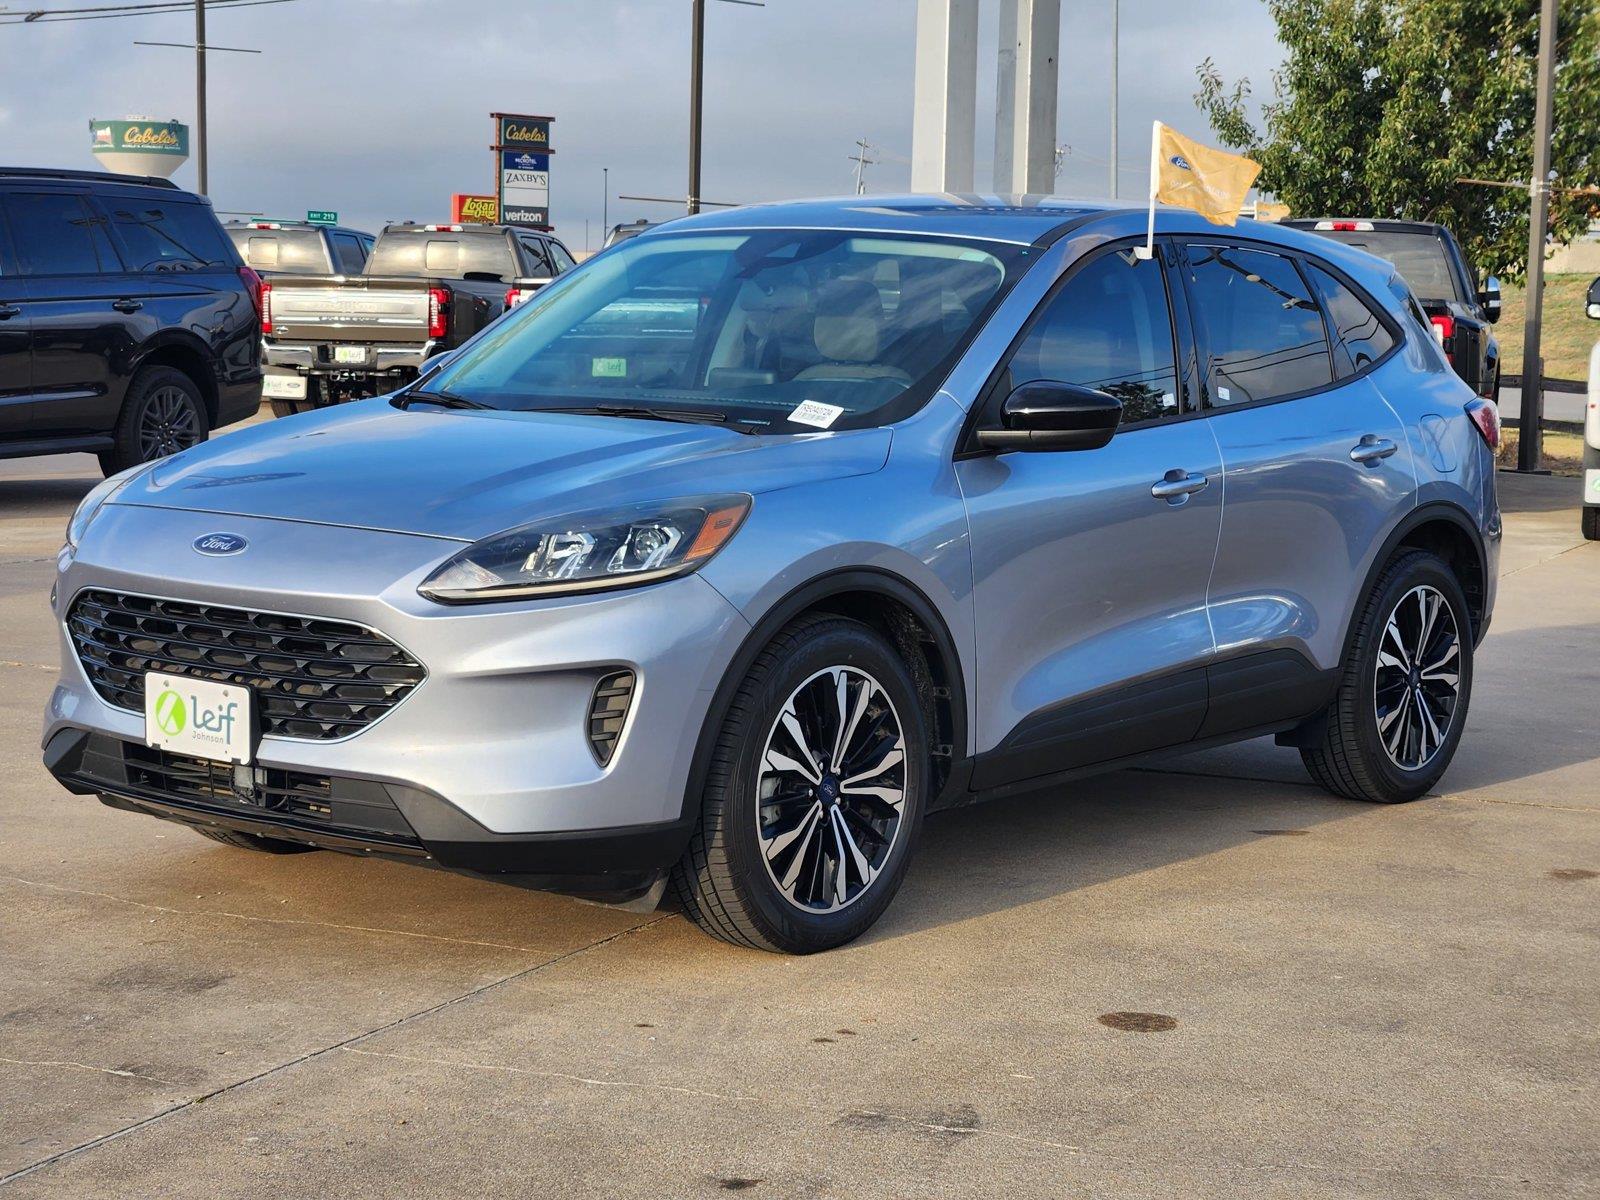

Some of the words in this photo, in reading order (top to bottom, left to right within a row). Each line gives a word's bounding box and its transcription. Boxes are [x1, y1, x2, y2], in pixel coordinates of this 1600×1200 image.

[506, 124, 546, 142] Cabela's
[506, 173, 546, 185] ZAXBY'S
[505, 210, 541, 222] verizon
[202, 536, 236, 551] Ford
[190, 695, 238, 745] leif
[192, 731, 224, 743] Johnson
